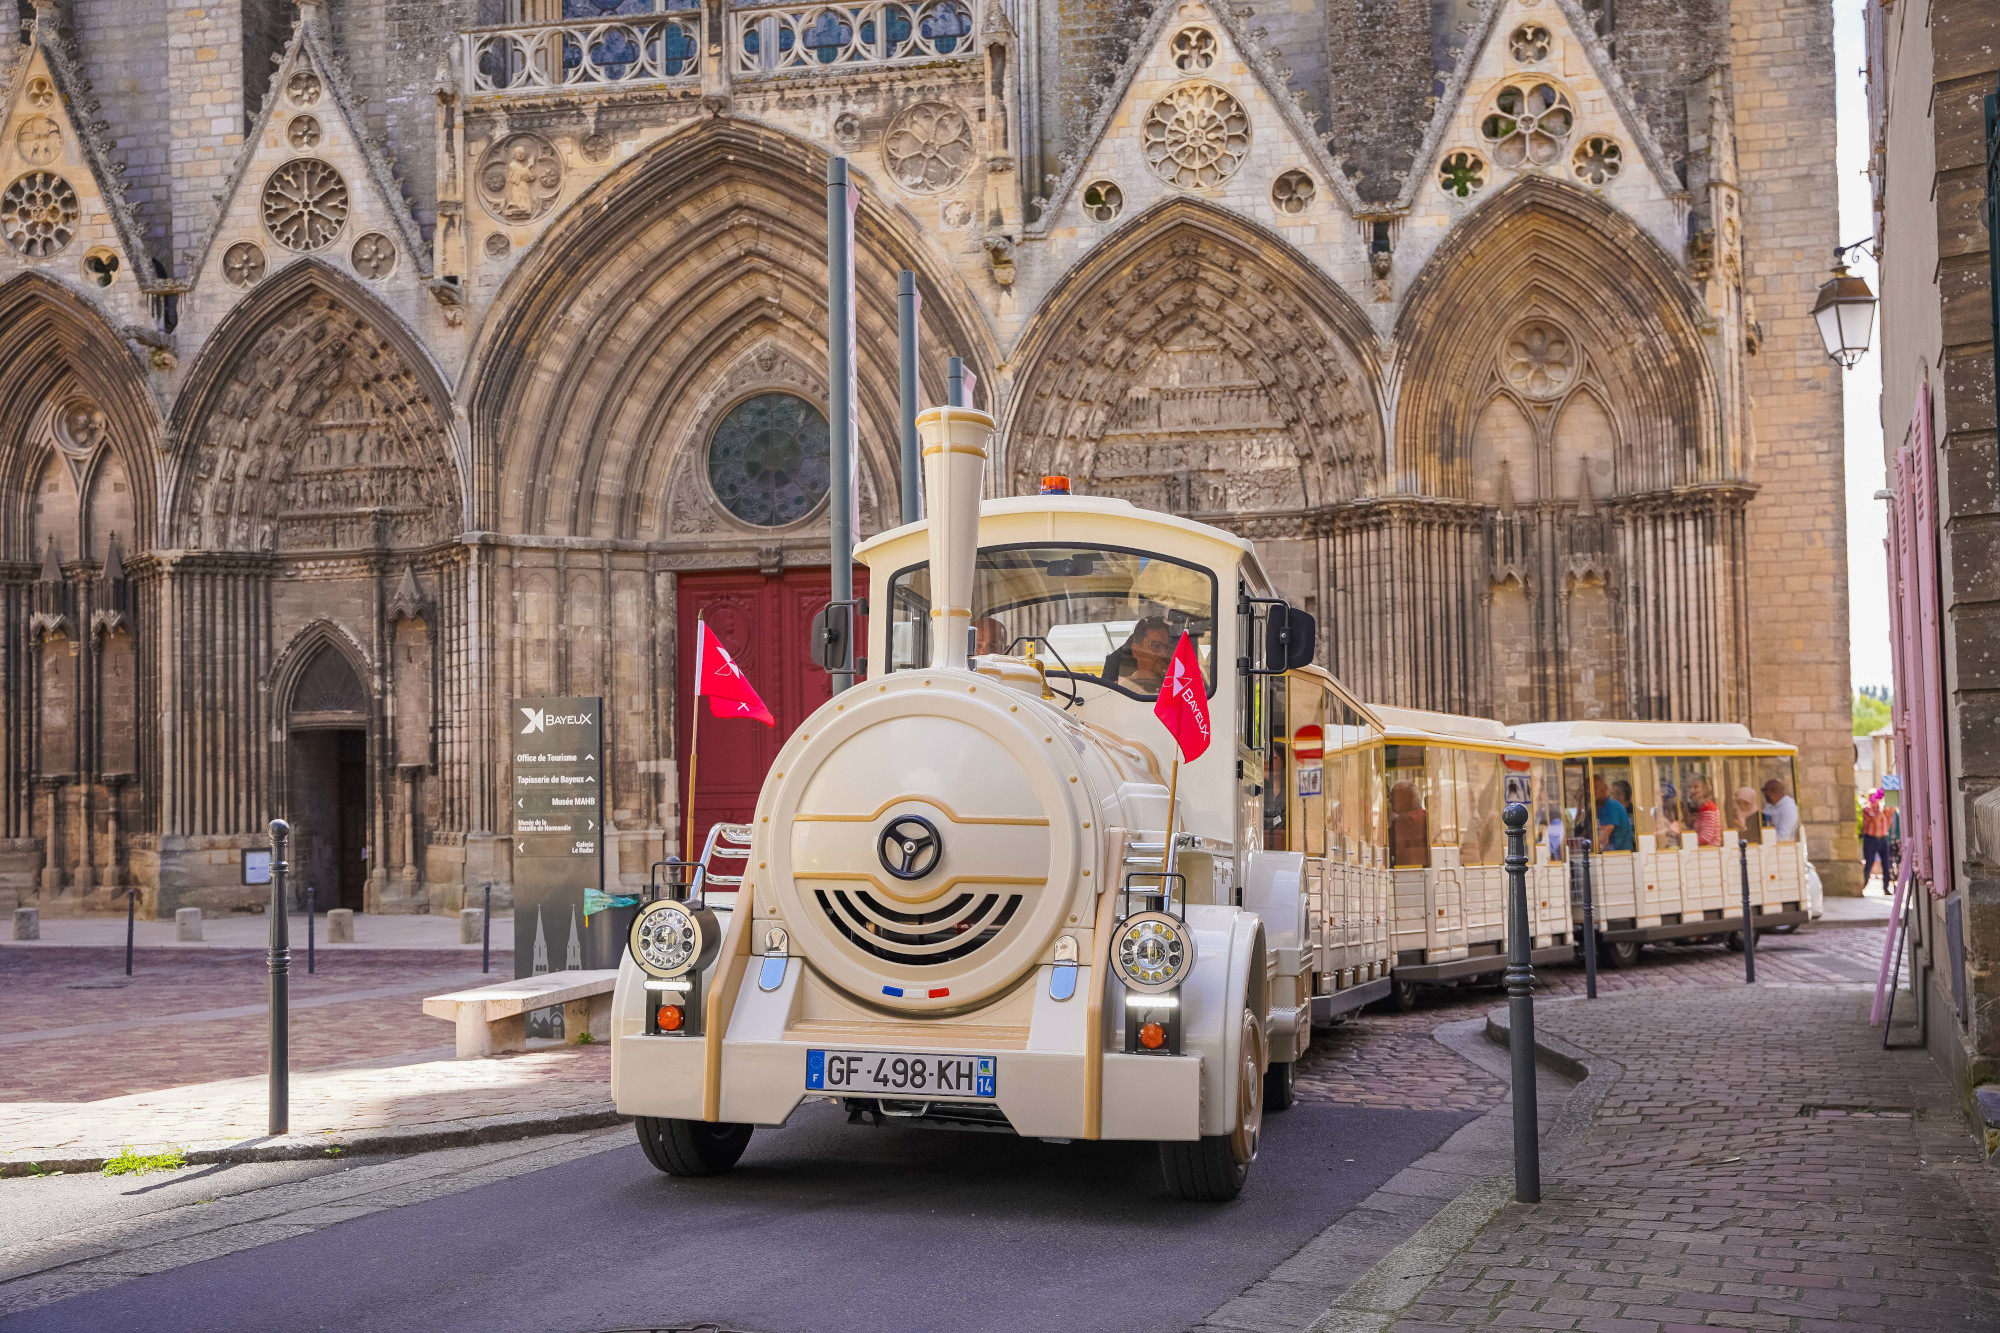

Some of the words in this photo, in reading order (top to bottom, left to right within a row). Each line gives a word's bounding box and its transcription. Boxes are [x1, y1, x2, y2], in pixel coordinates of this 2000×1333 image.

[545, 712, 592, 726] BAYEUX
[1181, 687, 1210, 742] BAYEUX
[517, 753, 537, 762] Office
[537, 753, 546, 762] de
[547, 753, 577, 762] Tourisme
[517, 775, 550, 785] Tapisserie
[550, 775, 560, 784] de
[560, 775, 584, 785] Bayeux
[552, 797, 573, 806] Musée
[574, 797, 596, 806] MAHB
[544, 824, 572, 832] Normandie
[576, 840, 594, 848] Galerie
[812, 1073, 819, 1082] F
[827, 1055, 974, 1090] GF-498-KH
[979, 1077, 993, 1093] 14
